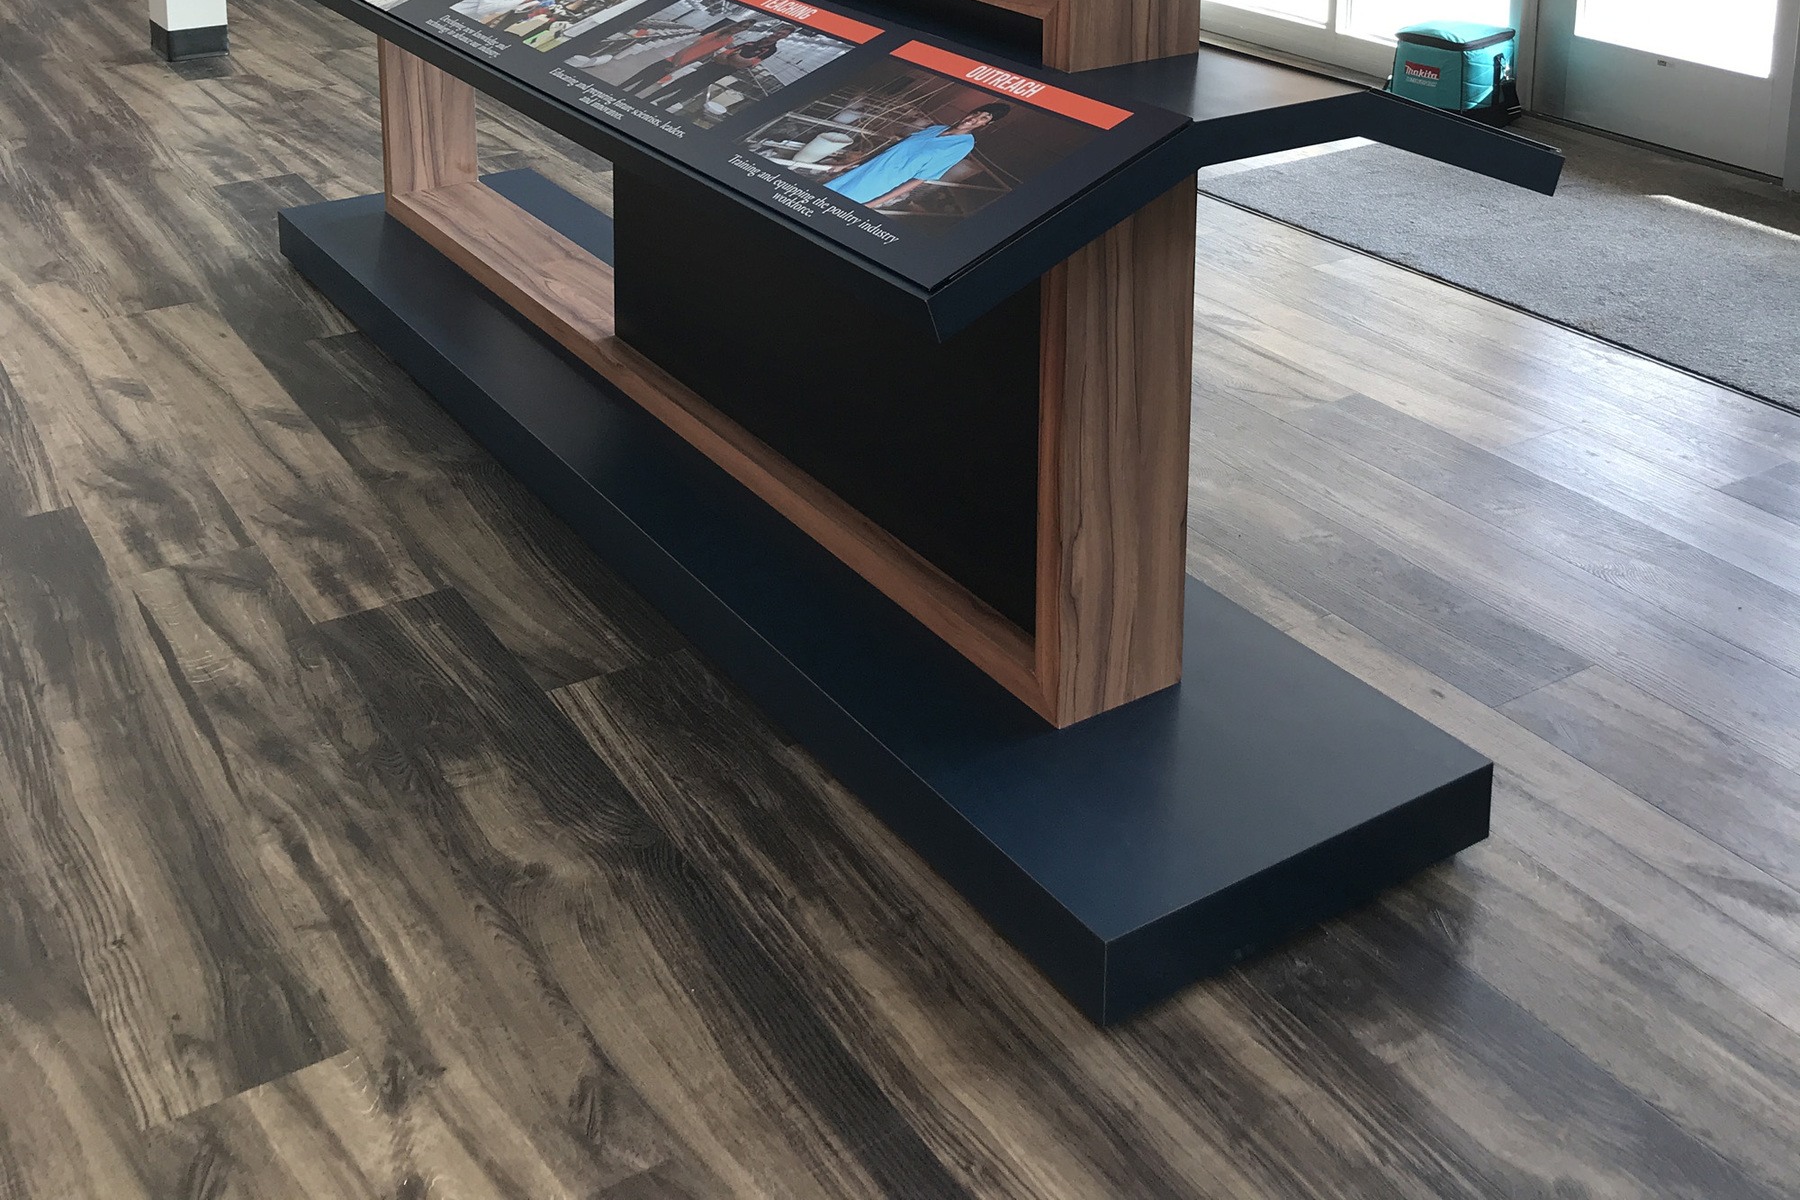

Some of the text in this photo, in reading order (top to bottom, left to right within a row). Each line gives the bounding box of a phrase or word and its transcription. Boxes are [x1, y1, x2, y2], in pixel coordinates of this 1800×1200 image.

[549, 67, 579, 86] Educating
[965, 65, 1045, 98] OUTREACH
[1405, 65, 1439, 80] Makita
[574, 82, 594, 90] and
[582, 87, 616, 105] preparing
[612, 98, 634, 112] future
[728, 153, 899, 244] Training and equipping the poultry industry
[772, 192, 813, 217] workforce.
